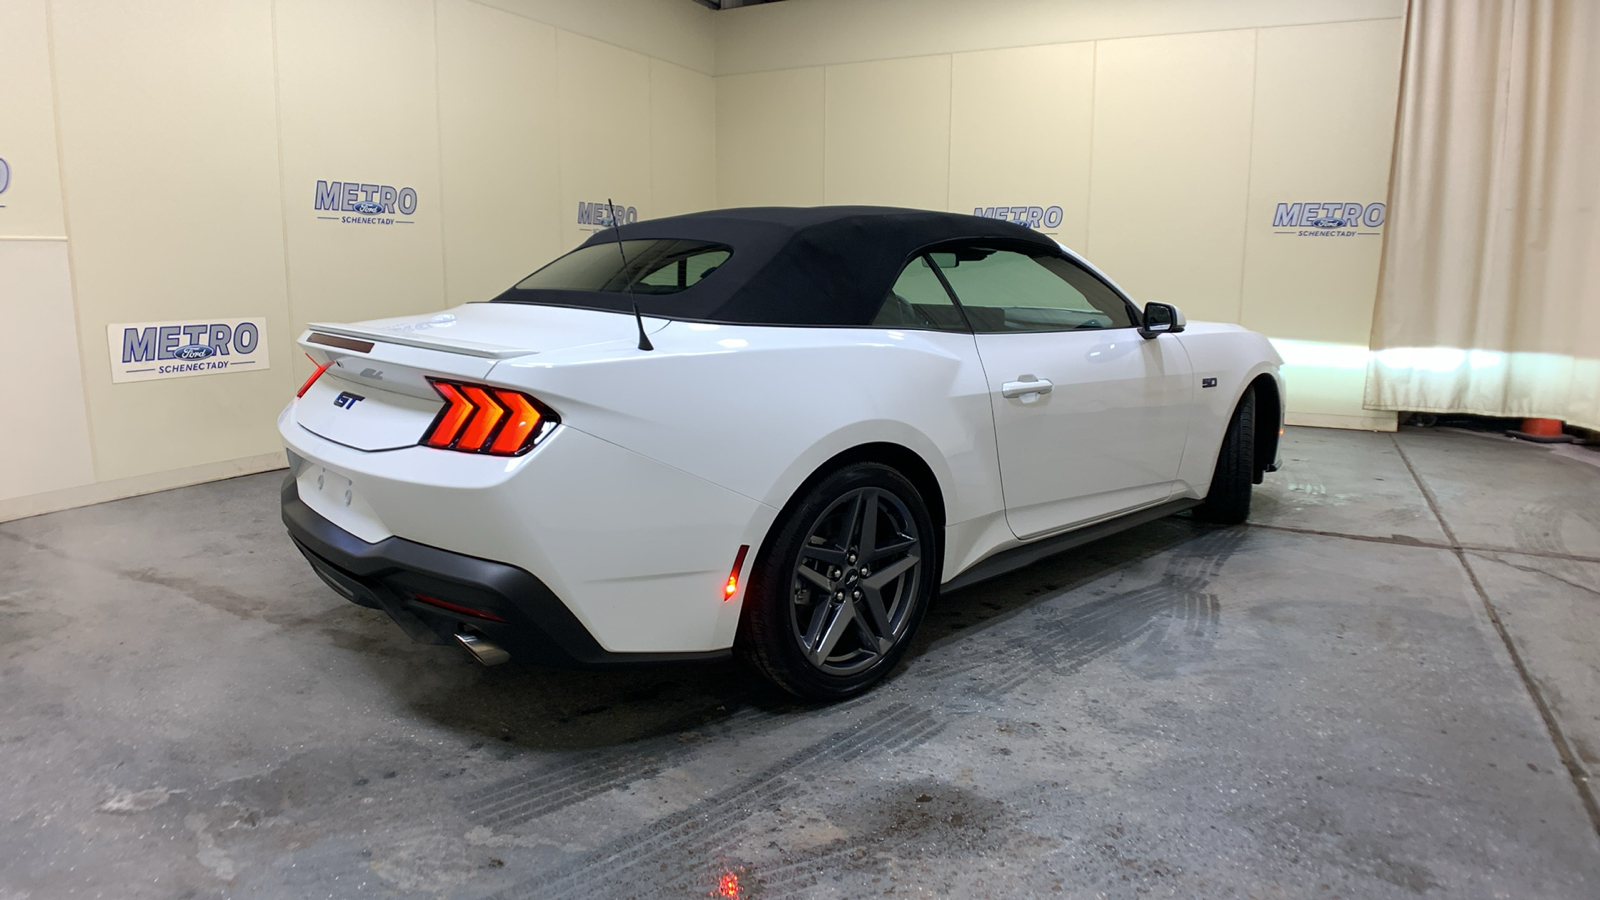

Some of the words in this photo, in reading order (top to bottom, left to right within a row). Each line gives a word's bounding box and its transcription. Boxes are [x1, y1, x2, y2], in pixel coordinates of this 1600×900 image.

[314, 180, 417, 215] METRO
[359, 203, 378, 213] Ford
[1272, 202, 1386, 228] METRO
[341, 216, 394, 225] SCHENECTADY
[122, 322, 259, 363] METRO
[181, 347, 207, 359] Ford
[158, 361, 229, 374] SCHENECTADY
[333, 391, 366, 410] GT
